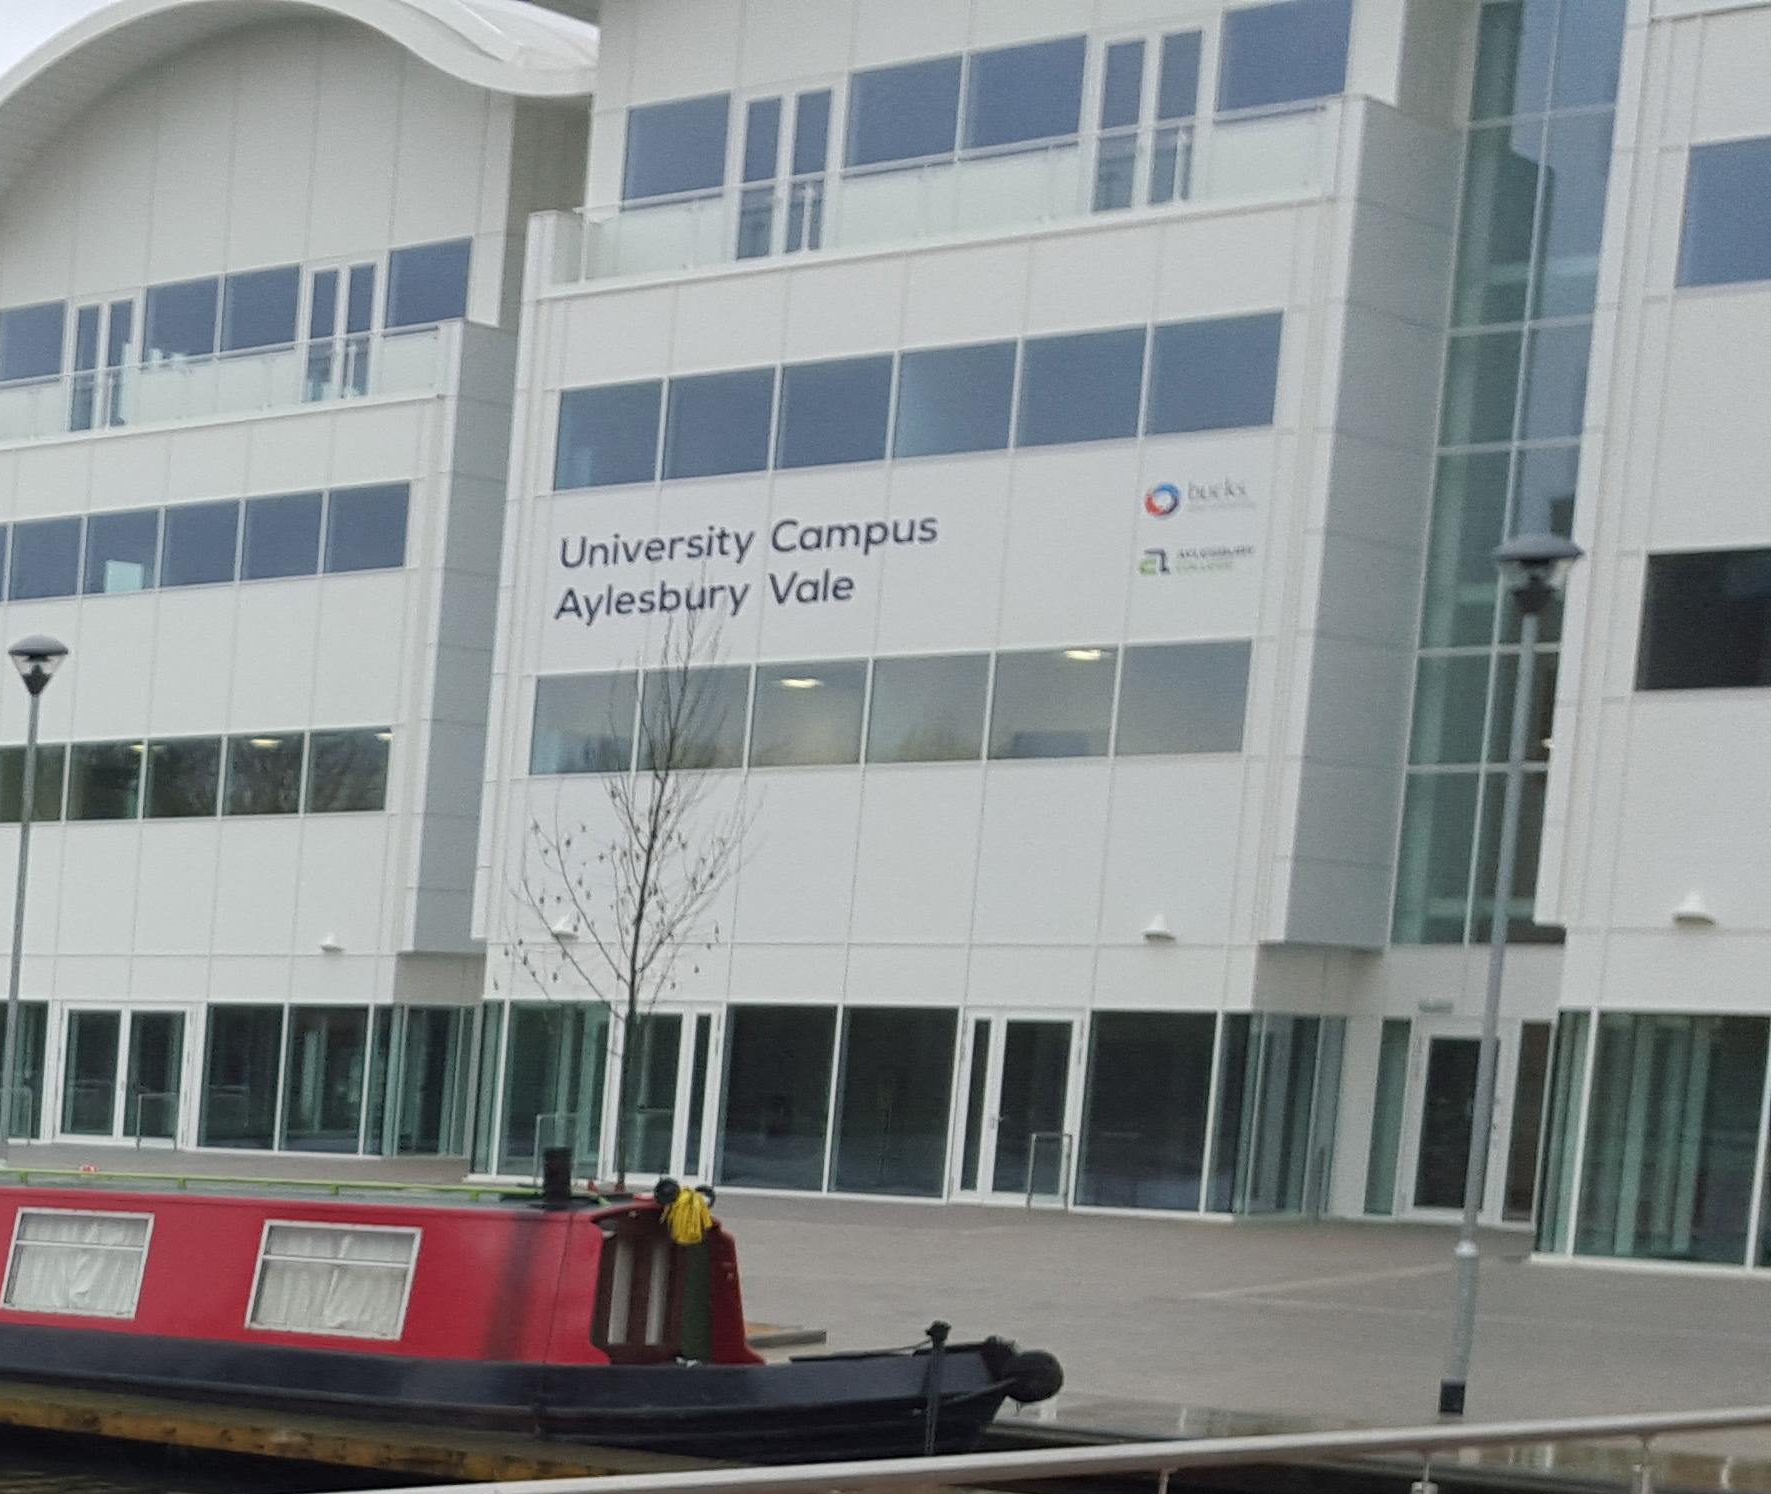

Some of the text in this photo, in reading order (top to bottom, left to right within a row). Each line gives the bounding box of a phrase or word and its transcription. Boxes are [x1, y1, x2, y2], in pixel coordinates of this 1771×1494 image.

[560, 517, 938, 569] University Campus
[554, 569, 854, 626] Aylesbury Vale
